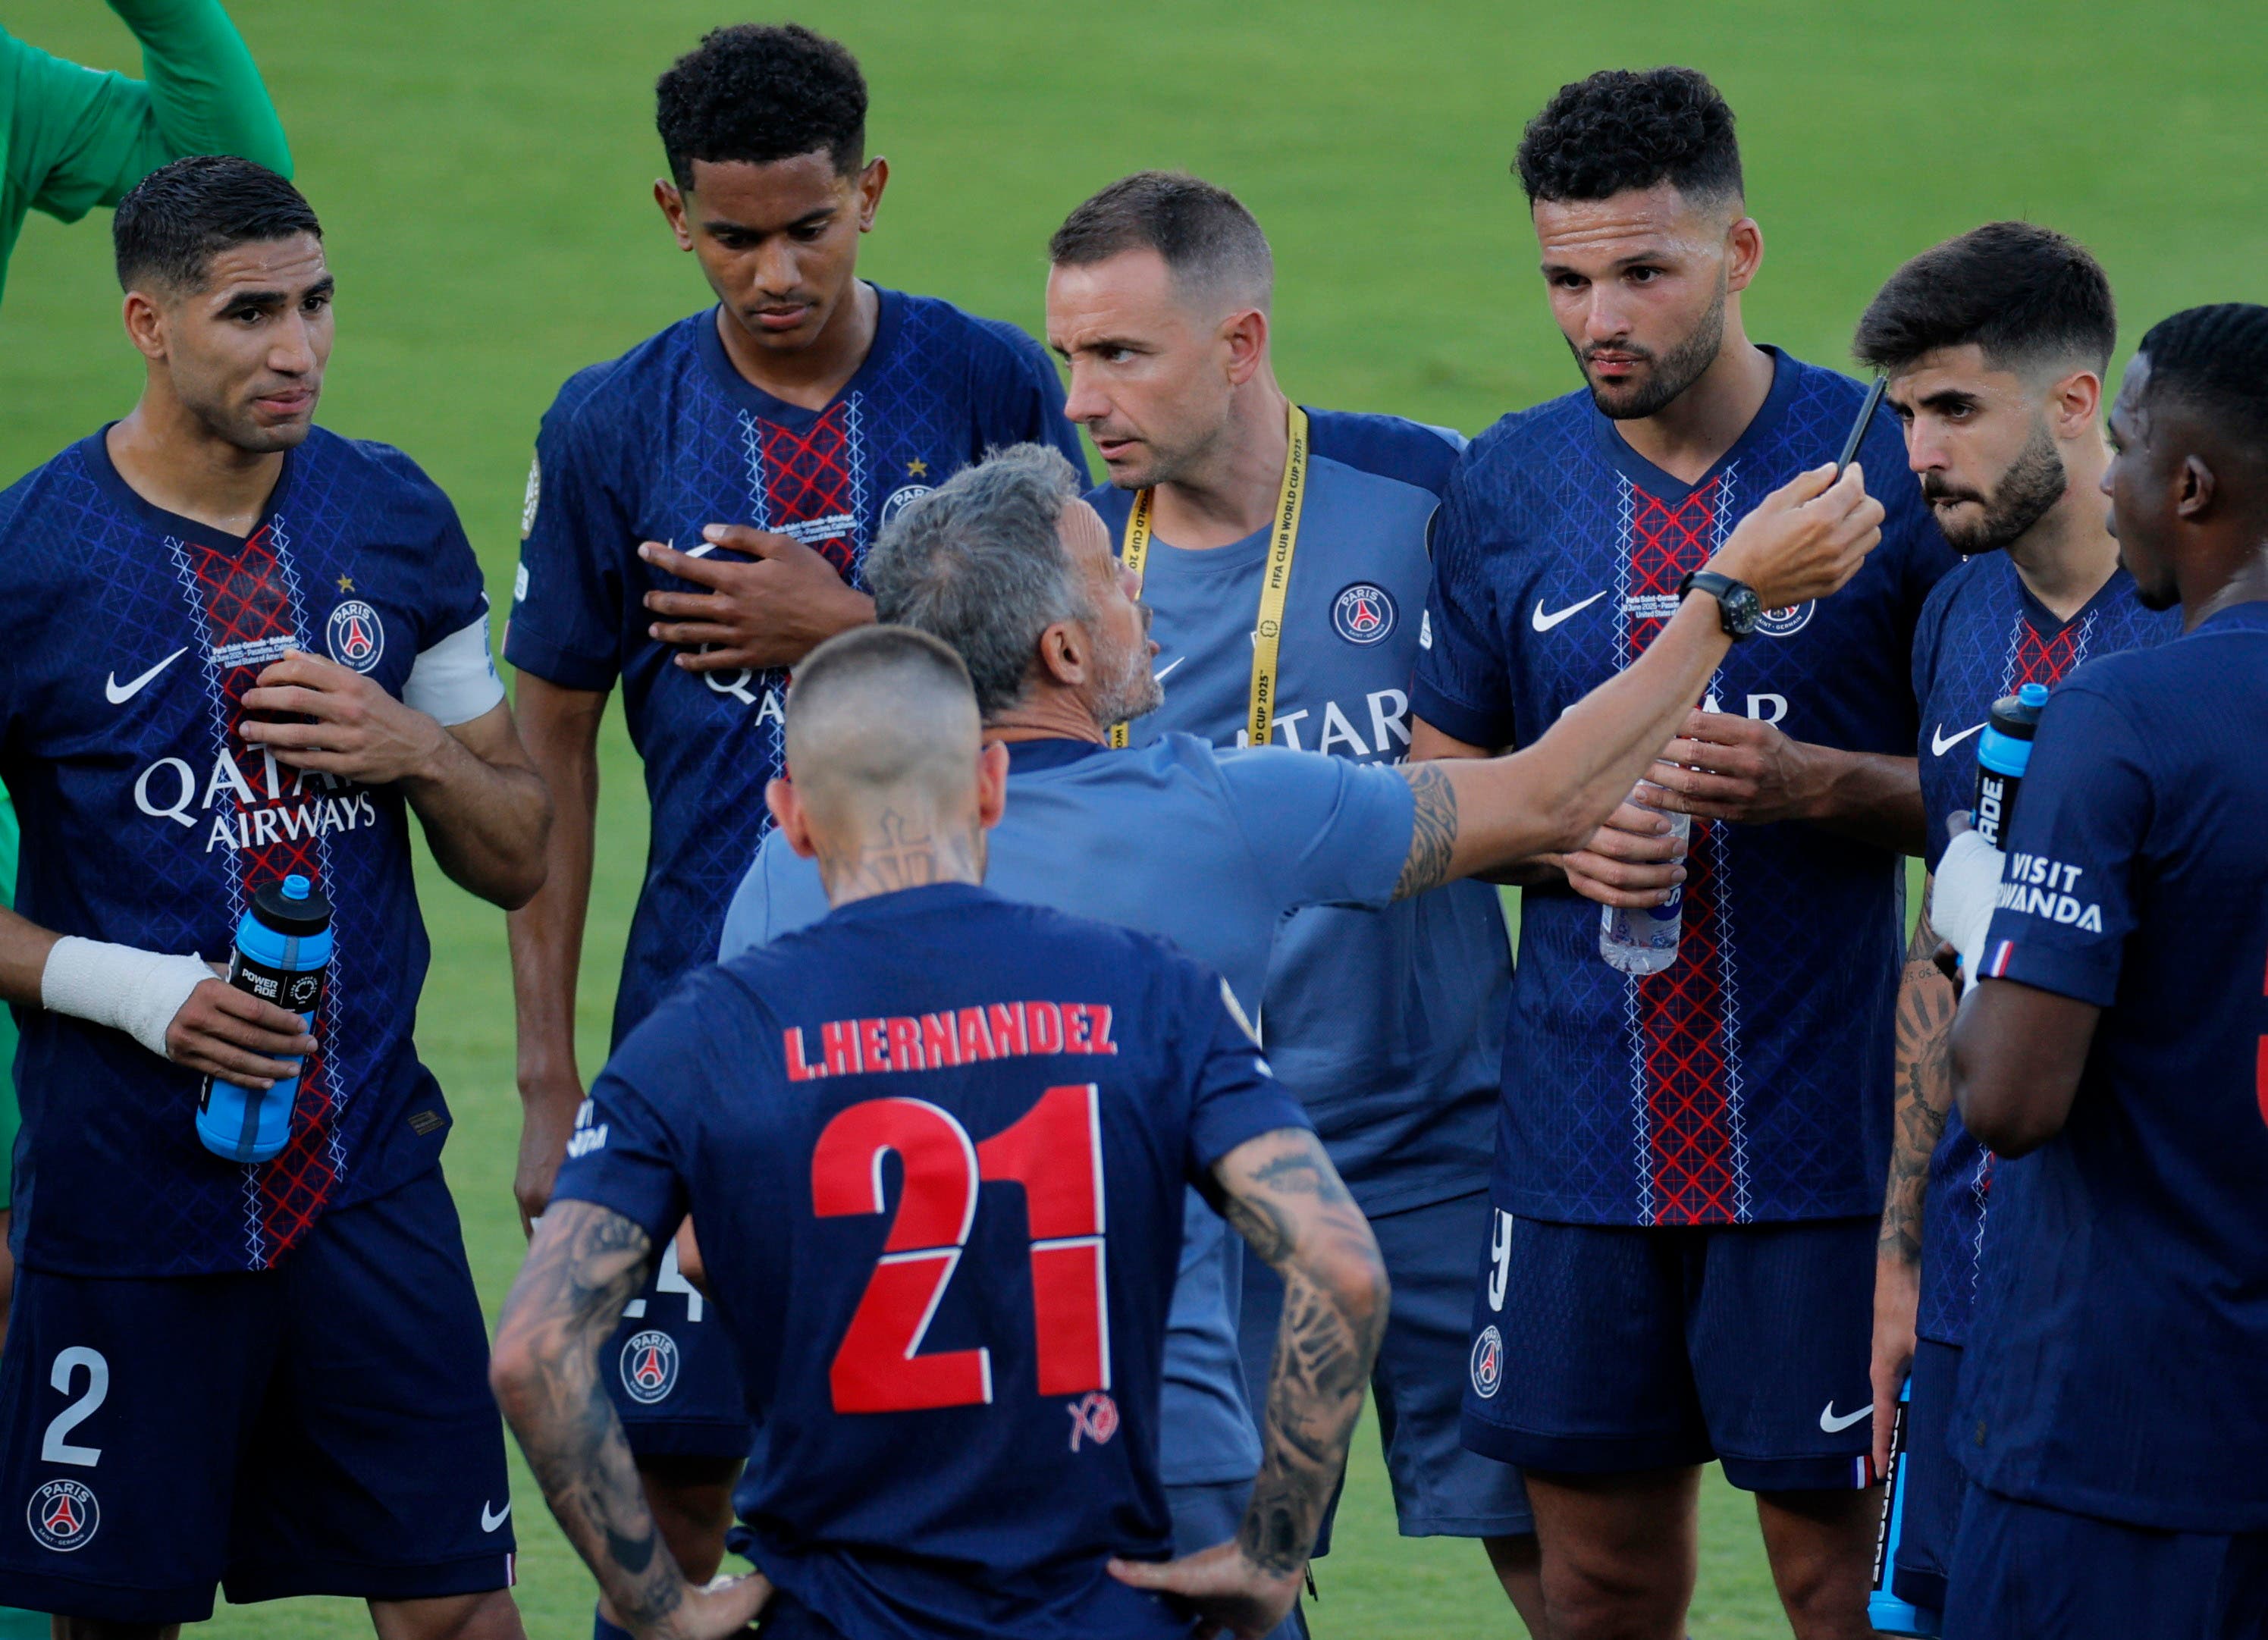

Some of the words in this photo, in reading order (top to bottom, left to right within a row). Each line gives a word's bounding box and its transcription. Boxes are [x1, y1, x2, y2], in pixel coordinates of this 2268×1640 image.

[1290, 466, 1300, 488] CUP
[893, 488, 927, 506] PAR
[1281, 491, 1297, 533] WORLD
[1132, 530, 1143, 552] CUP
[1276, 533, 1289, 563] CLUB
[1129, 555, 1139, 569] 20
[1272, 566, 1284, 589] FIFA
[1341, 589, 1379, 606] PARIS
[333, 604, 371, 624] PARIS
[1758, 618, 1772, 629] AINT
[1238, 688, 1412, 756] TAR
[1256, 707, 1267, 729] CUP
[1978, 776, 2004, 844] ADE
[205, 791, 376, 853] AIRWAYS
[2011, 852, 2083, 893] VISIT
[1996, 882, 2102, 933] WANDA
[242, 968, 279, 989] POWER
[254, 984, 278, 998] ADE
[783, 1000, 1118, 1083] L.HERNANDEZ
[811, 1083, 1111, 1416] 21
[1488, 1207, 1514, 1312] 9
[622, 1234, 703, 1322] 4
[631, 1334, 673, 1354] PARIS
[41, 1345, 109, 1467] 2
[42, 1483, 90, 1503] PARIS
